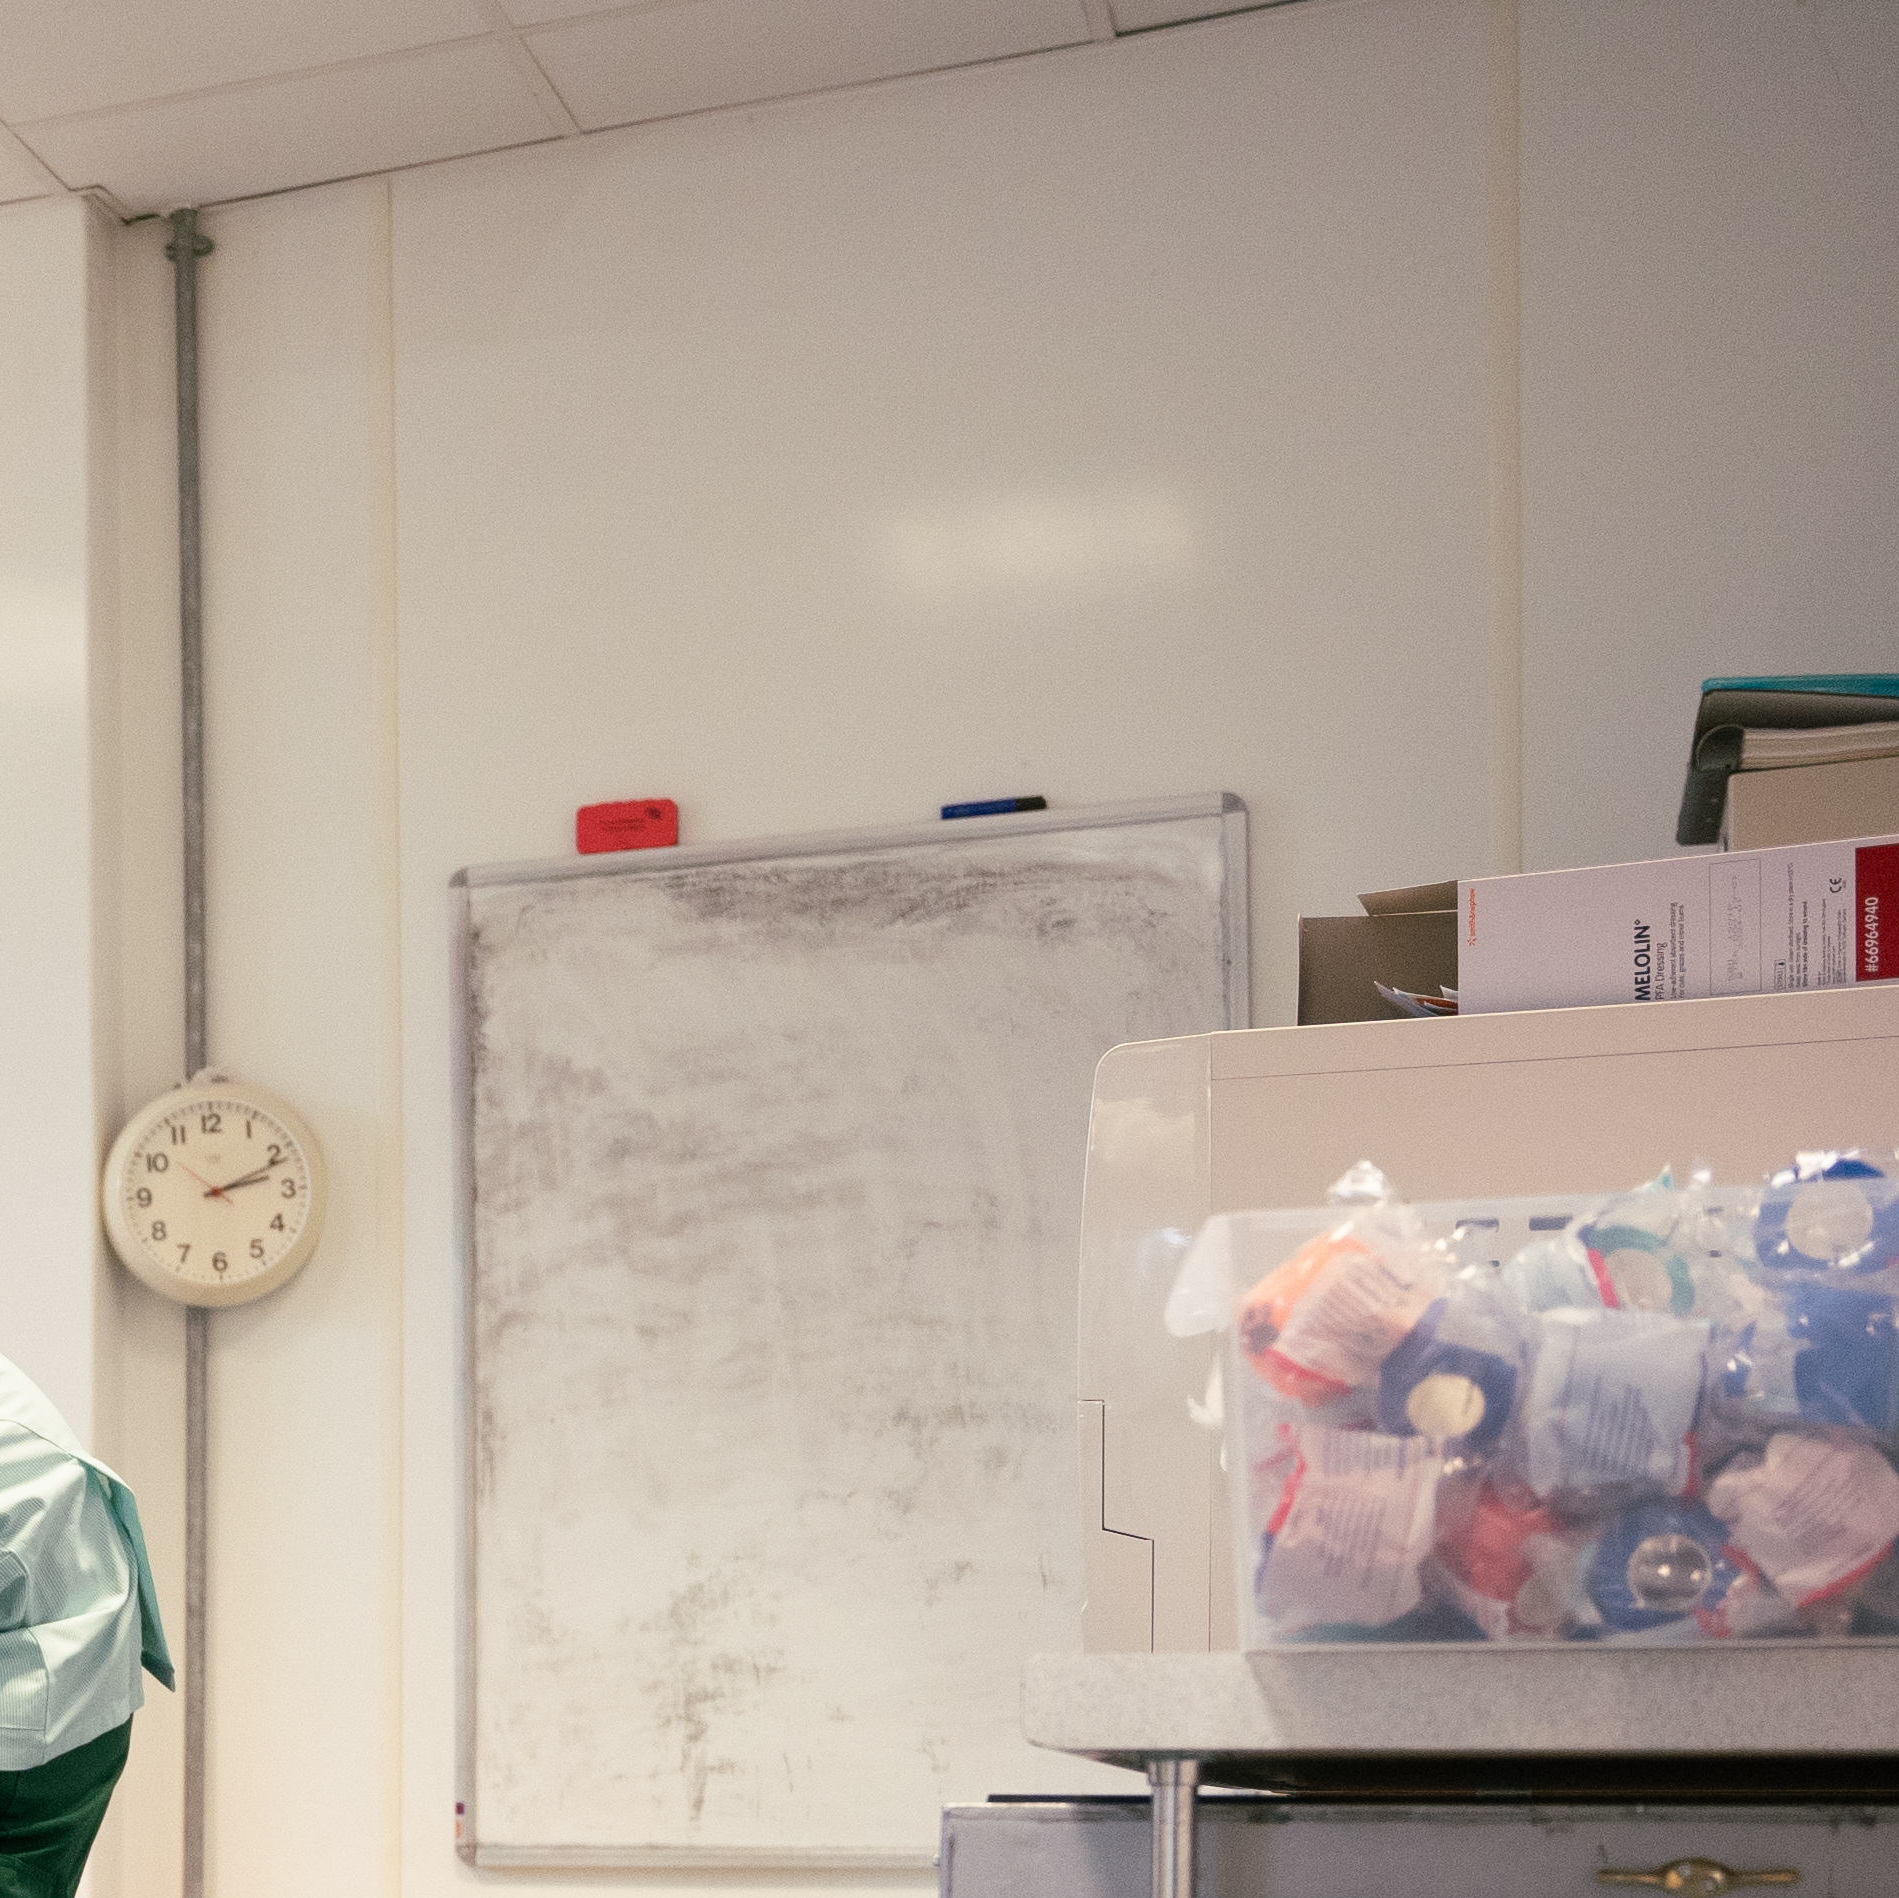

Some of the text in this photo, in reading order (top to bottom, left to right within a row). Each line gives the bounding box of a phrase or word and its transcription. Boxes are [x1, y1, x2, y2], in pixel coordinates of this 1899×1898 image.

[1864, 896, 1879, 973] #66964940
[1633, 925, 1651, 1001] MELOLIN
[1655, 942, 1668, 1000] PFA Dressing
[201, 1113, 222, 1134] 12
[245, 1119, 252, 1139] 1
[170, 1125, 186, 1145] 11
[146, 1152, 169, 1173] 10
[266, 1144, 282, 1166] 2
[136, 1187, 152, 1208] 9
[280, 1178, 297, 1199] 3
[152, 1220, 167, 1241] 8
[269, 1213, 285, 1232] 4
[177, 1243, 191, 1263] 7
[249, 1239, 265, 1259] 5
[212, 1252, 228, 1272] 6
